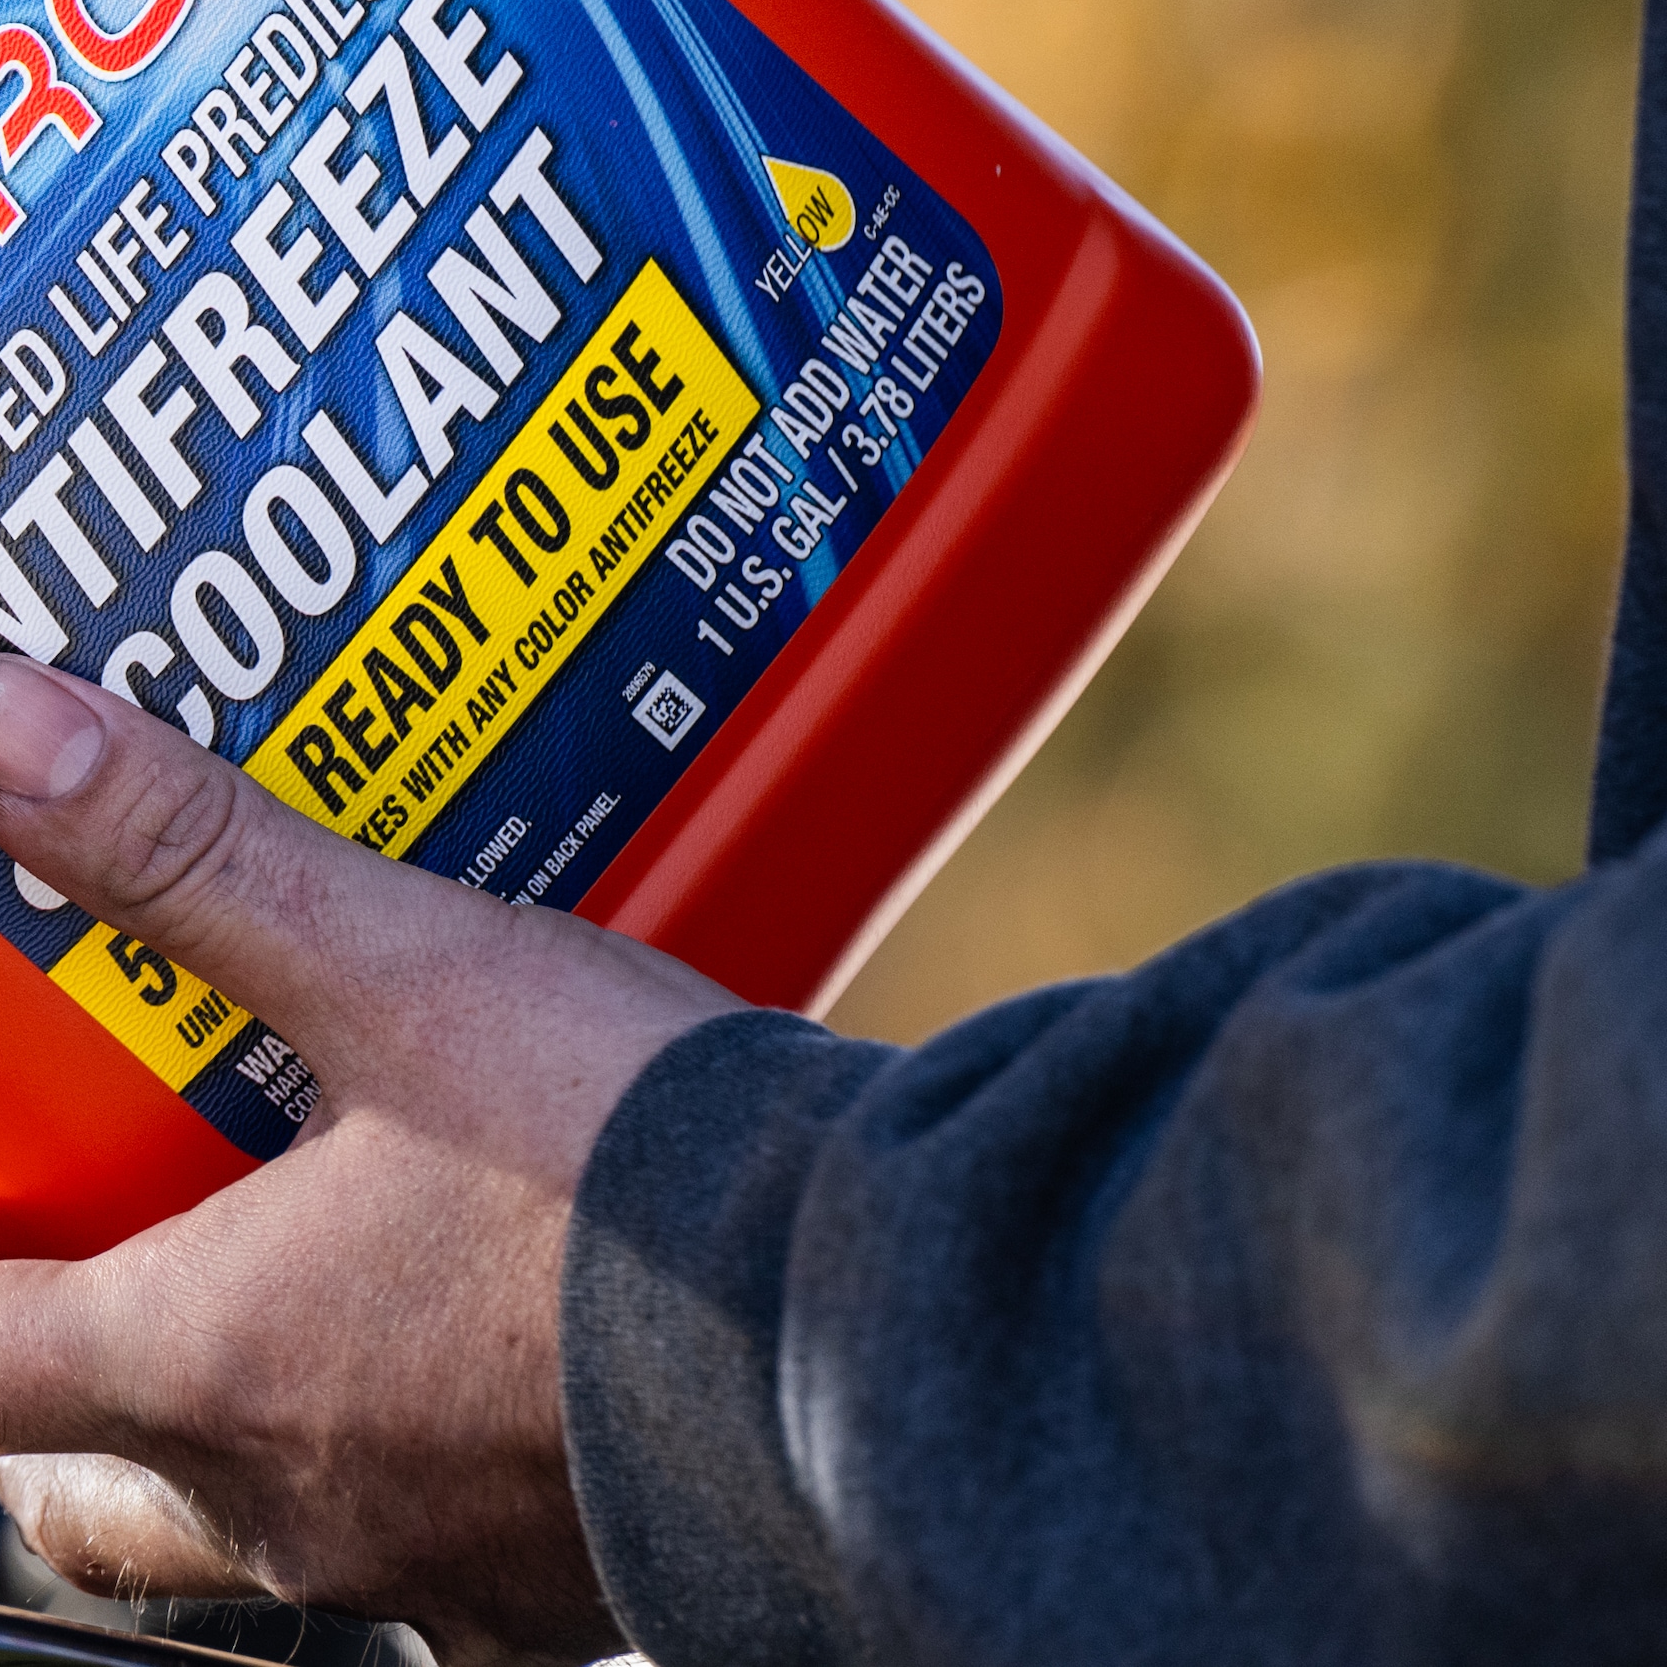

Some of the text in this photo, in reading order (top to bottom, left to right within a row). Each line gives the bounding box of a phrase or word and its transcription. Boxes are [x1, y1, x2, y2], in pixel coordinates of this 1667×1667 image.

[47, 178, 191, 358] LIFE
[664, 235, 934, 592] DO NOT ADD WATER
[755, 186, 834, 302] YELLOW
[101, 126, 603, 748] COOLANT
[284, 557, 492, 817] READY
[467, 468, 571, 589] TO
[547, 319, 685, 491] USE
[697, 261, 985, 657] 1 U.S. GAL / 3.78 LITERS
[175, 408, 719, 1049] UNI XES WITH ANY COLOR ANTIFREEZE
[527, 869, 552, 896] ON
[544, 831, 584, 876] BACK
[575, 792, 621, 839] PANEL.
[236, 816, 532, 1085] WA LLOWED.
